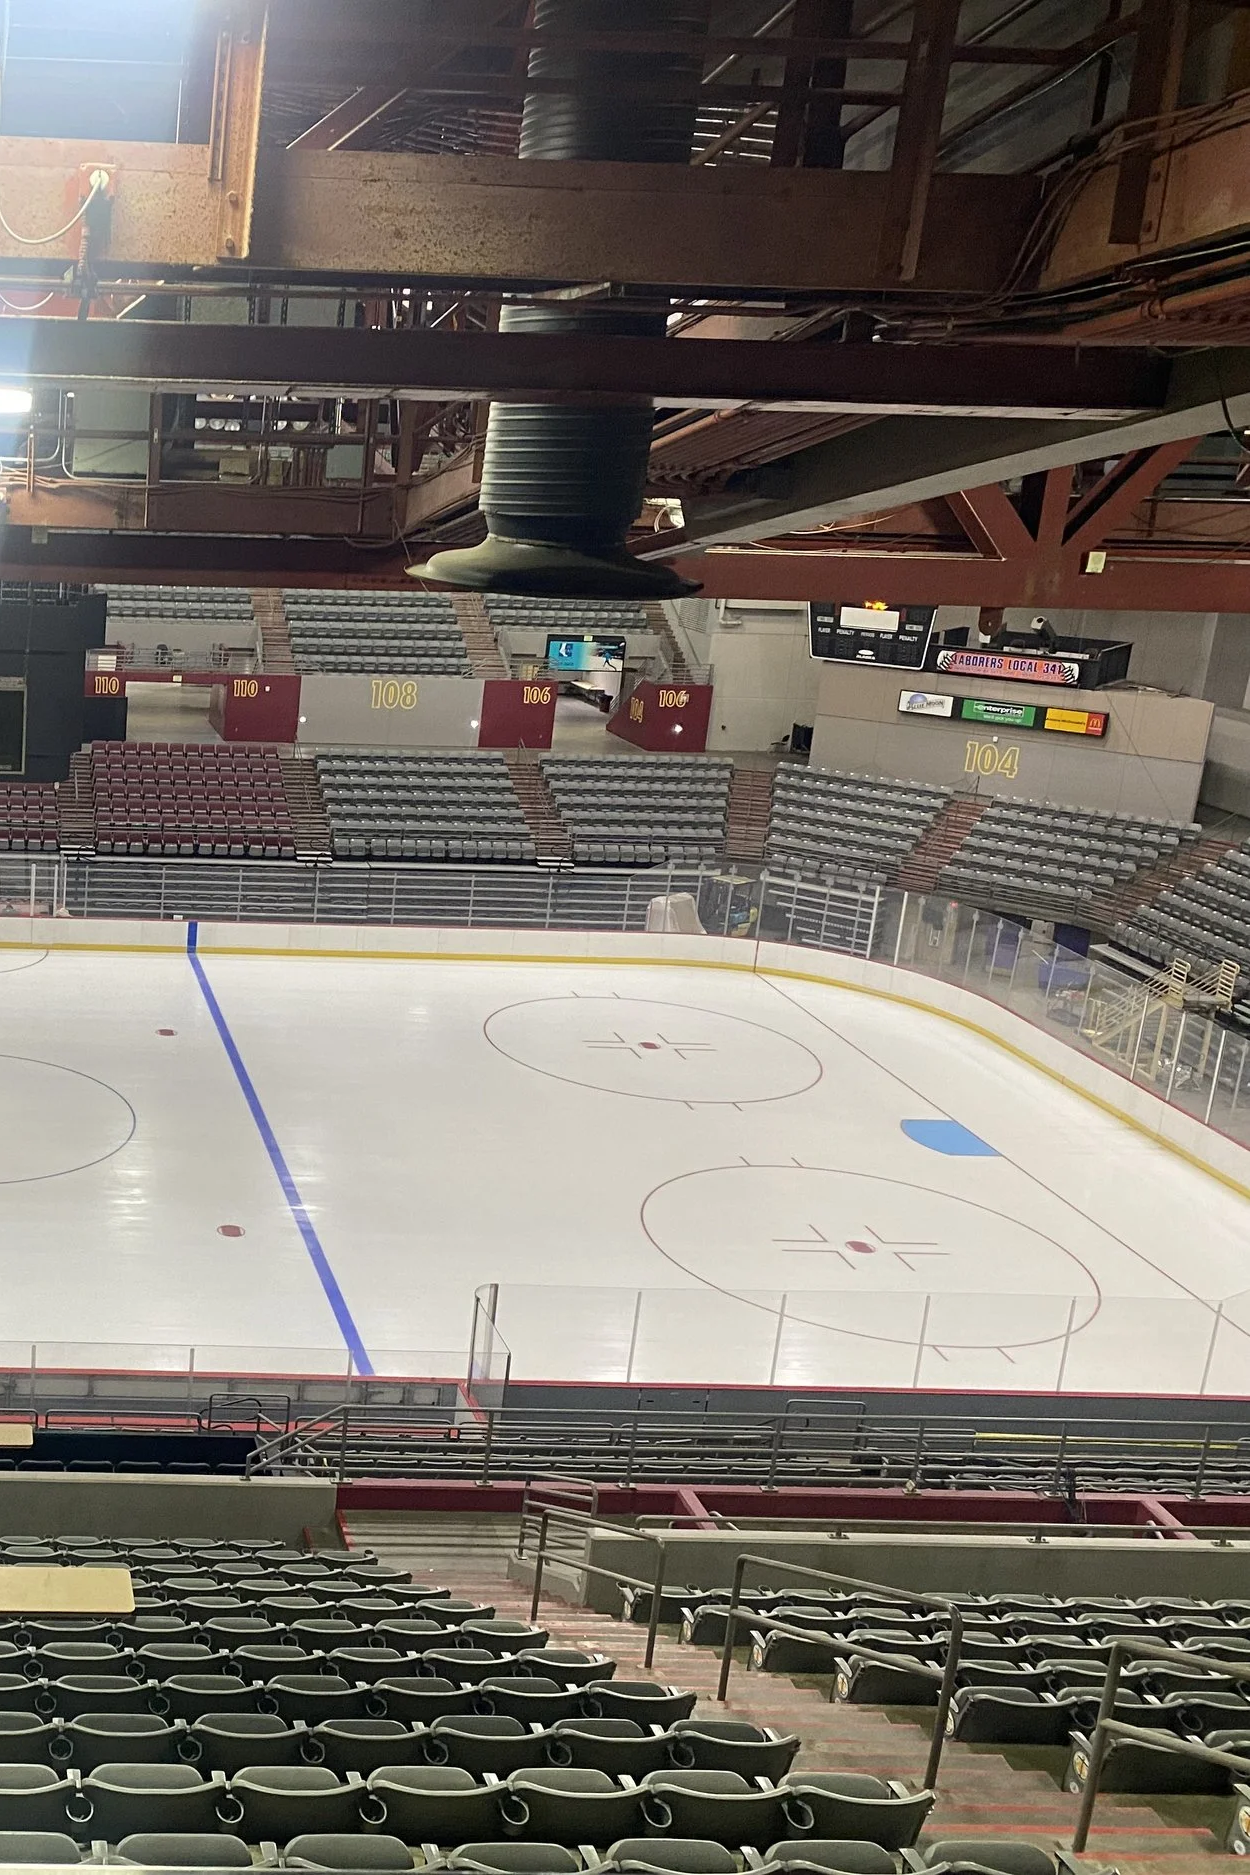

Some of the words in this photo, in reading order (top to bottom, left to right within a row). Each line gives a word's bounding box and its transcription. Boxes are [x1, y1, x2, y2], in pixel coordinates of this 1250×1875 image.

[836, 628, 855, 636] PENALTY
[953, 653, 1004, 669] LABORERS
[1008, 660, 1038, 673] LOCAL
[1042, 662, 1063, 675] 341
[95, 676, 120, 694] 110
[233, 679, 259, 697] 110
[371, 680, 417, 710] 108
[523, 686, 551, 705] 106
[659, 689, 687, 708] 106
[629, 696, 644, 724] 104
[976, 703, 1023, 716] enterprise
[964, 740, 1020, 779] 104
